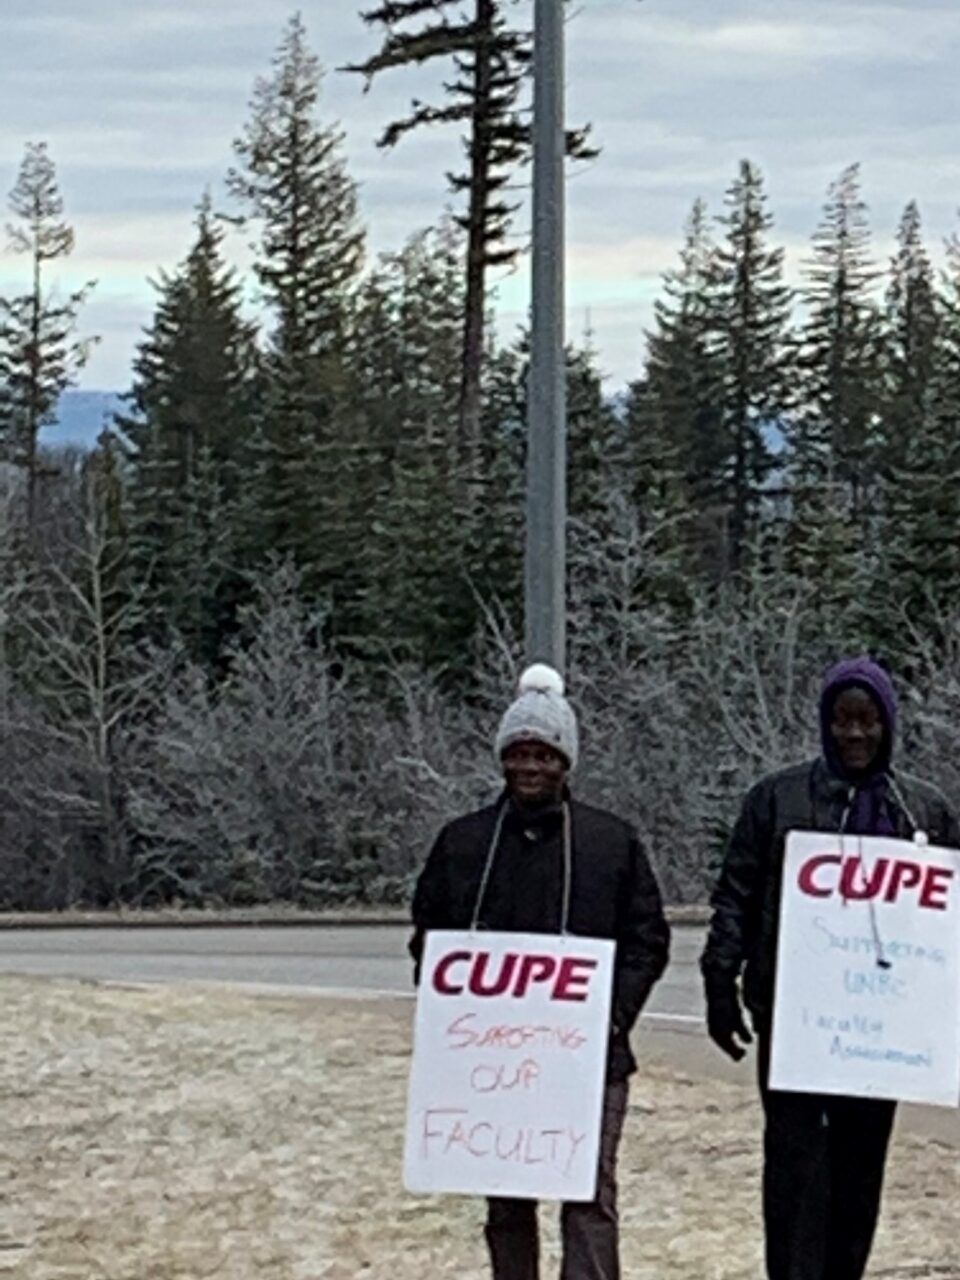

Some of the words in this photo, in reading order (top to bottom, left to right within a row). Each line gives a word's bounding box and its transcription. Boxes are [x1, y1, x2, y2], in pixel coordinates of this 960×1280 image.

[797, 854, 955, 909] CUPE
[432, 952, 598, 1001] CUPE
[421, 1107, 586, 1177] FACULTY
